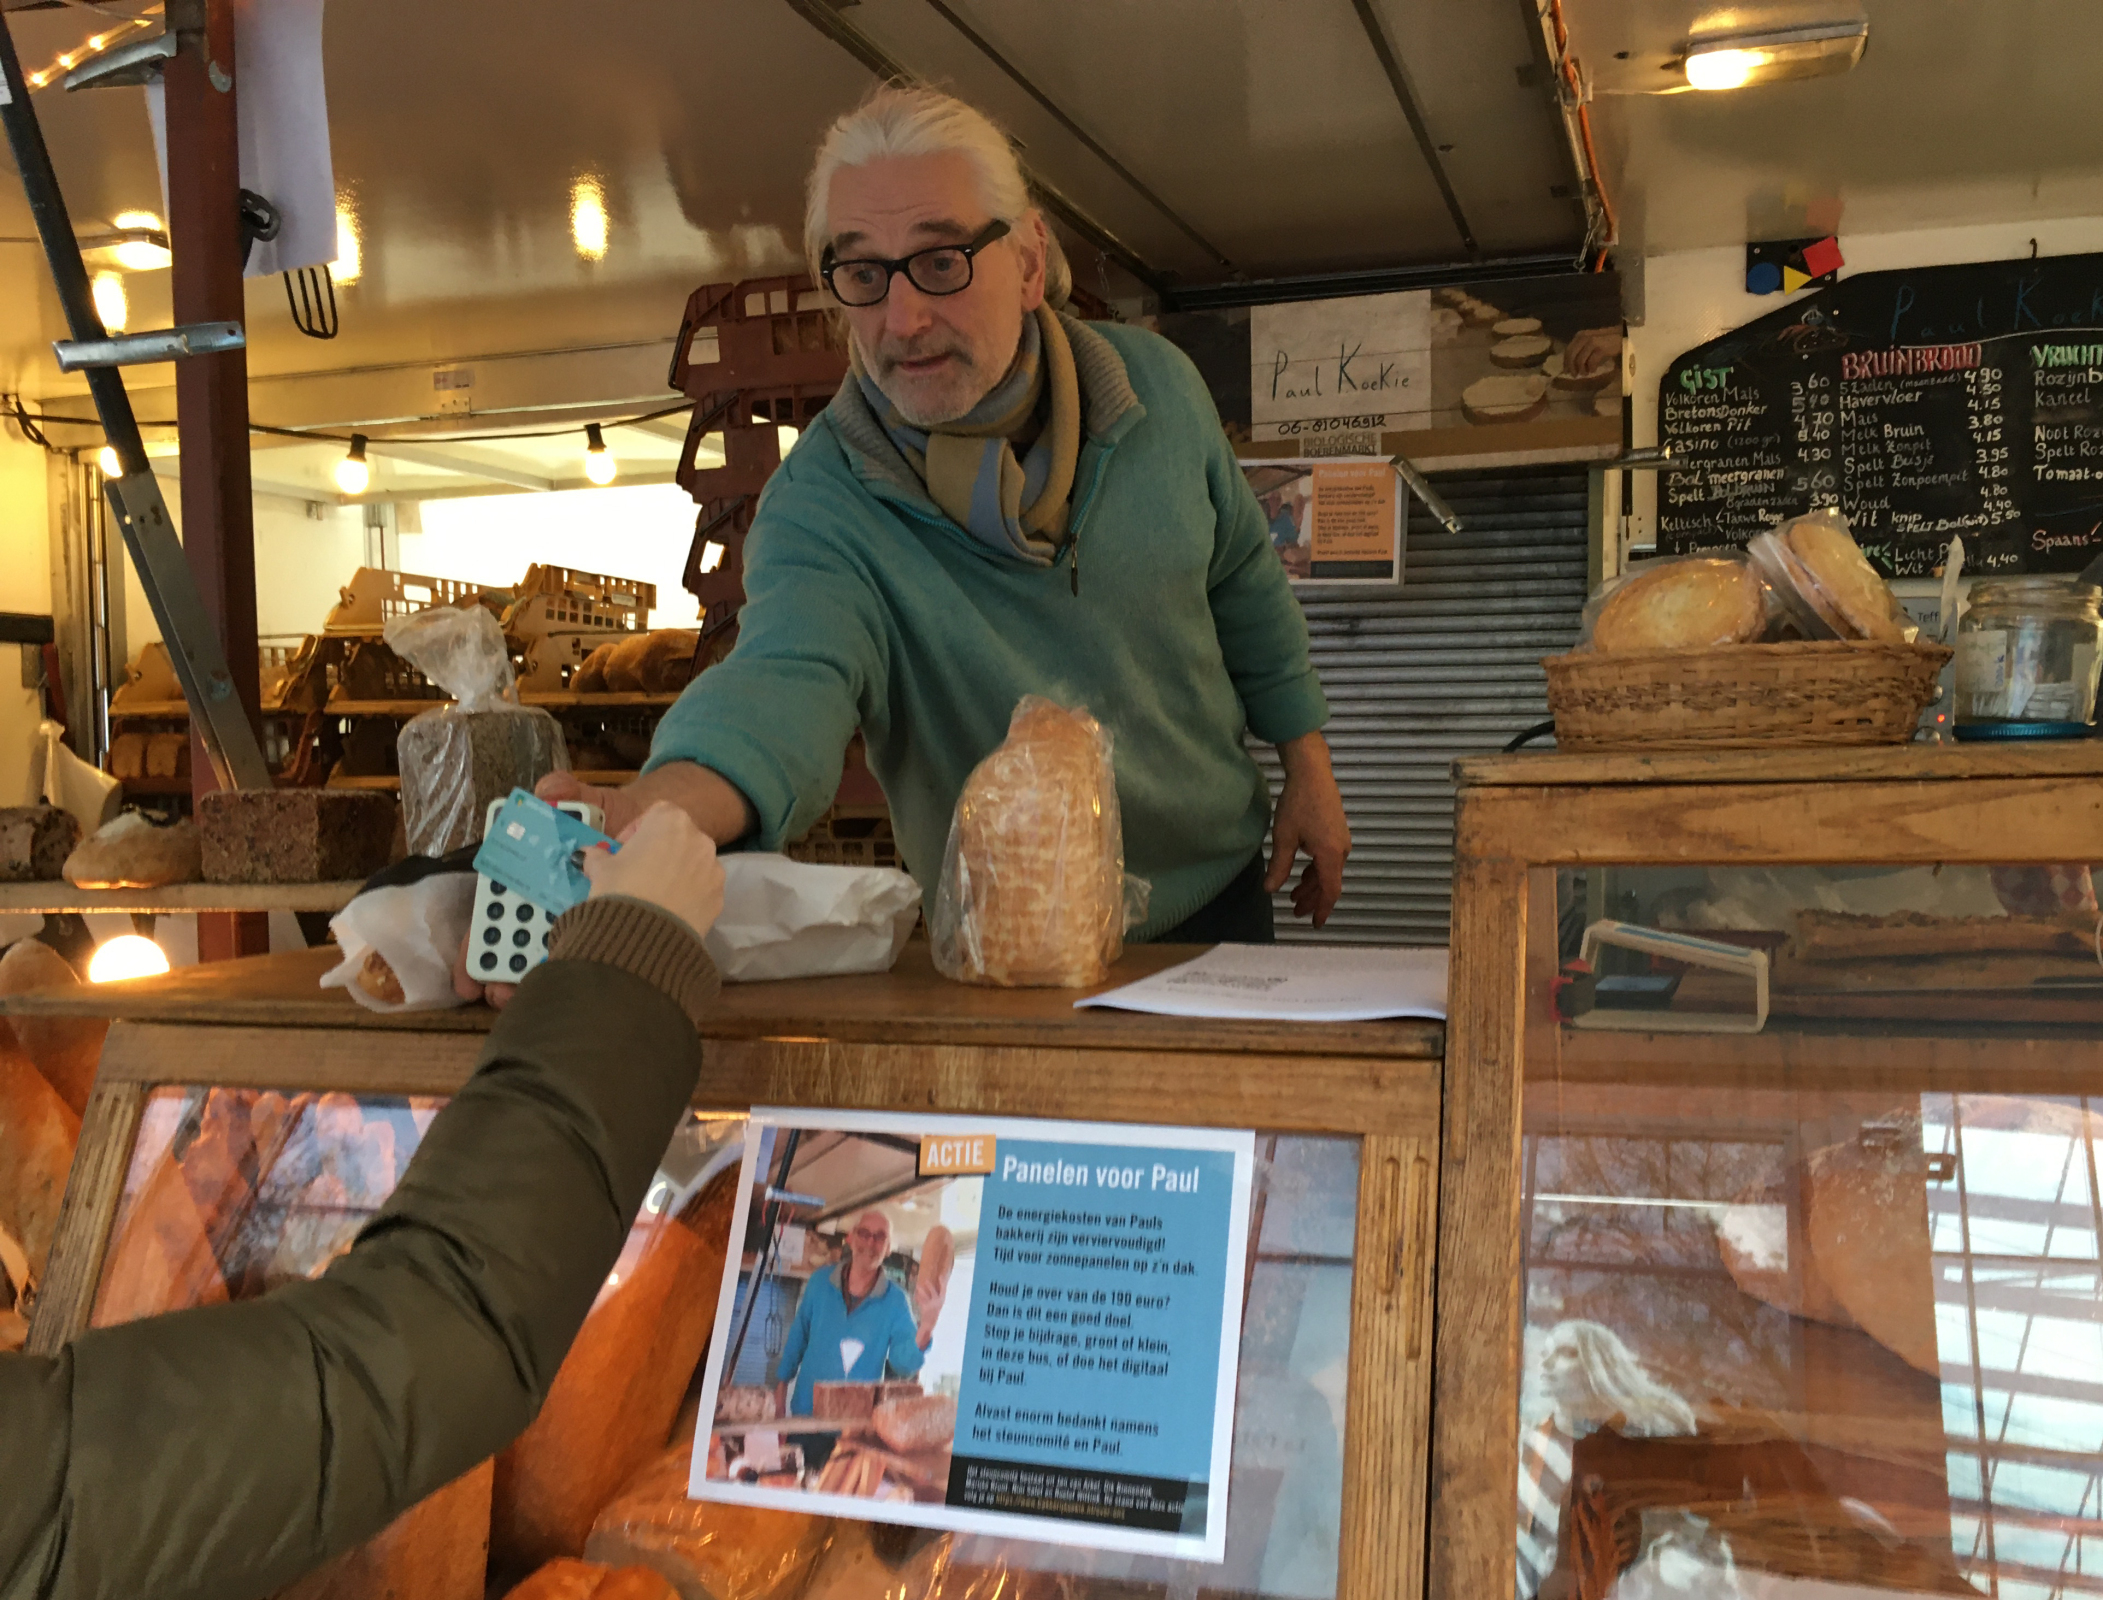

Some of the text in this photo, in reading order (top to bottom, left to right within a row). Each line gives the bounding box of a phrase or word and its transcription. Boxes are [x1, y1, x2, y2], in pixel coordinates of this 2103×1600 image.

[1272, 350, 1323, 401] Paul
[2034, 387, 2092, 408] Kaneel
[1303, 432, 1377, 447] BIOLOGISCHE
[1841, 428, 1879, 442] Melk
[1884, 423, 1925, 439] Bruin
[2034, 442, 2076, 462] Spelt
[1844, 457, 1885, 477] Spelt
[1668, 487, 1706, 507] Spelt
[1843, 495, 1892, 511] Woud
[2031, 529, 2089, 554] Spaans
[926, 1139, 984, 1169] ACTIE
[1002, 1154, 1200, 1194] Panelen voor Paul
[998, 1204, 1163, 1231] De energiekosten van Pauls
[996, 1225, 1166, 1254] bakkerij zijn verviervoudigd!
[994, 1246, 1198, 1276] Tijd voor zonnepanelen op z'n dak.
[989, 1280, 1171, 1310] Houd je over van de 190 euro?
[986, 1302, 1134, 1330] Dan is dit een goed doel.
[984, 1322, 1171, 1356] Stop je bijdrage, groot of klein,
[979, 1365, 1027, 1386] bij Paul.
[981, 1345, 1169, 1378] in deze bus, of doe het digitaal
[974, 1401, 1159, 1437] Alvast enorm bedankt namens
[972, 1424, 1123, 1455] het steuncomité en Paul.
